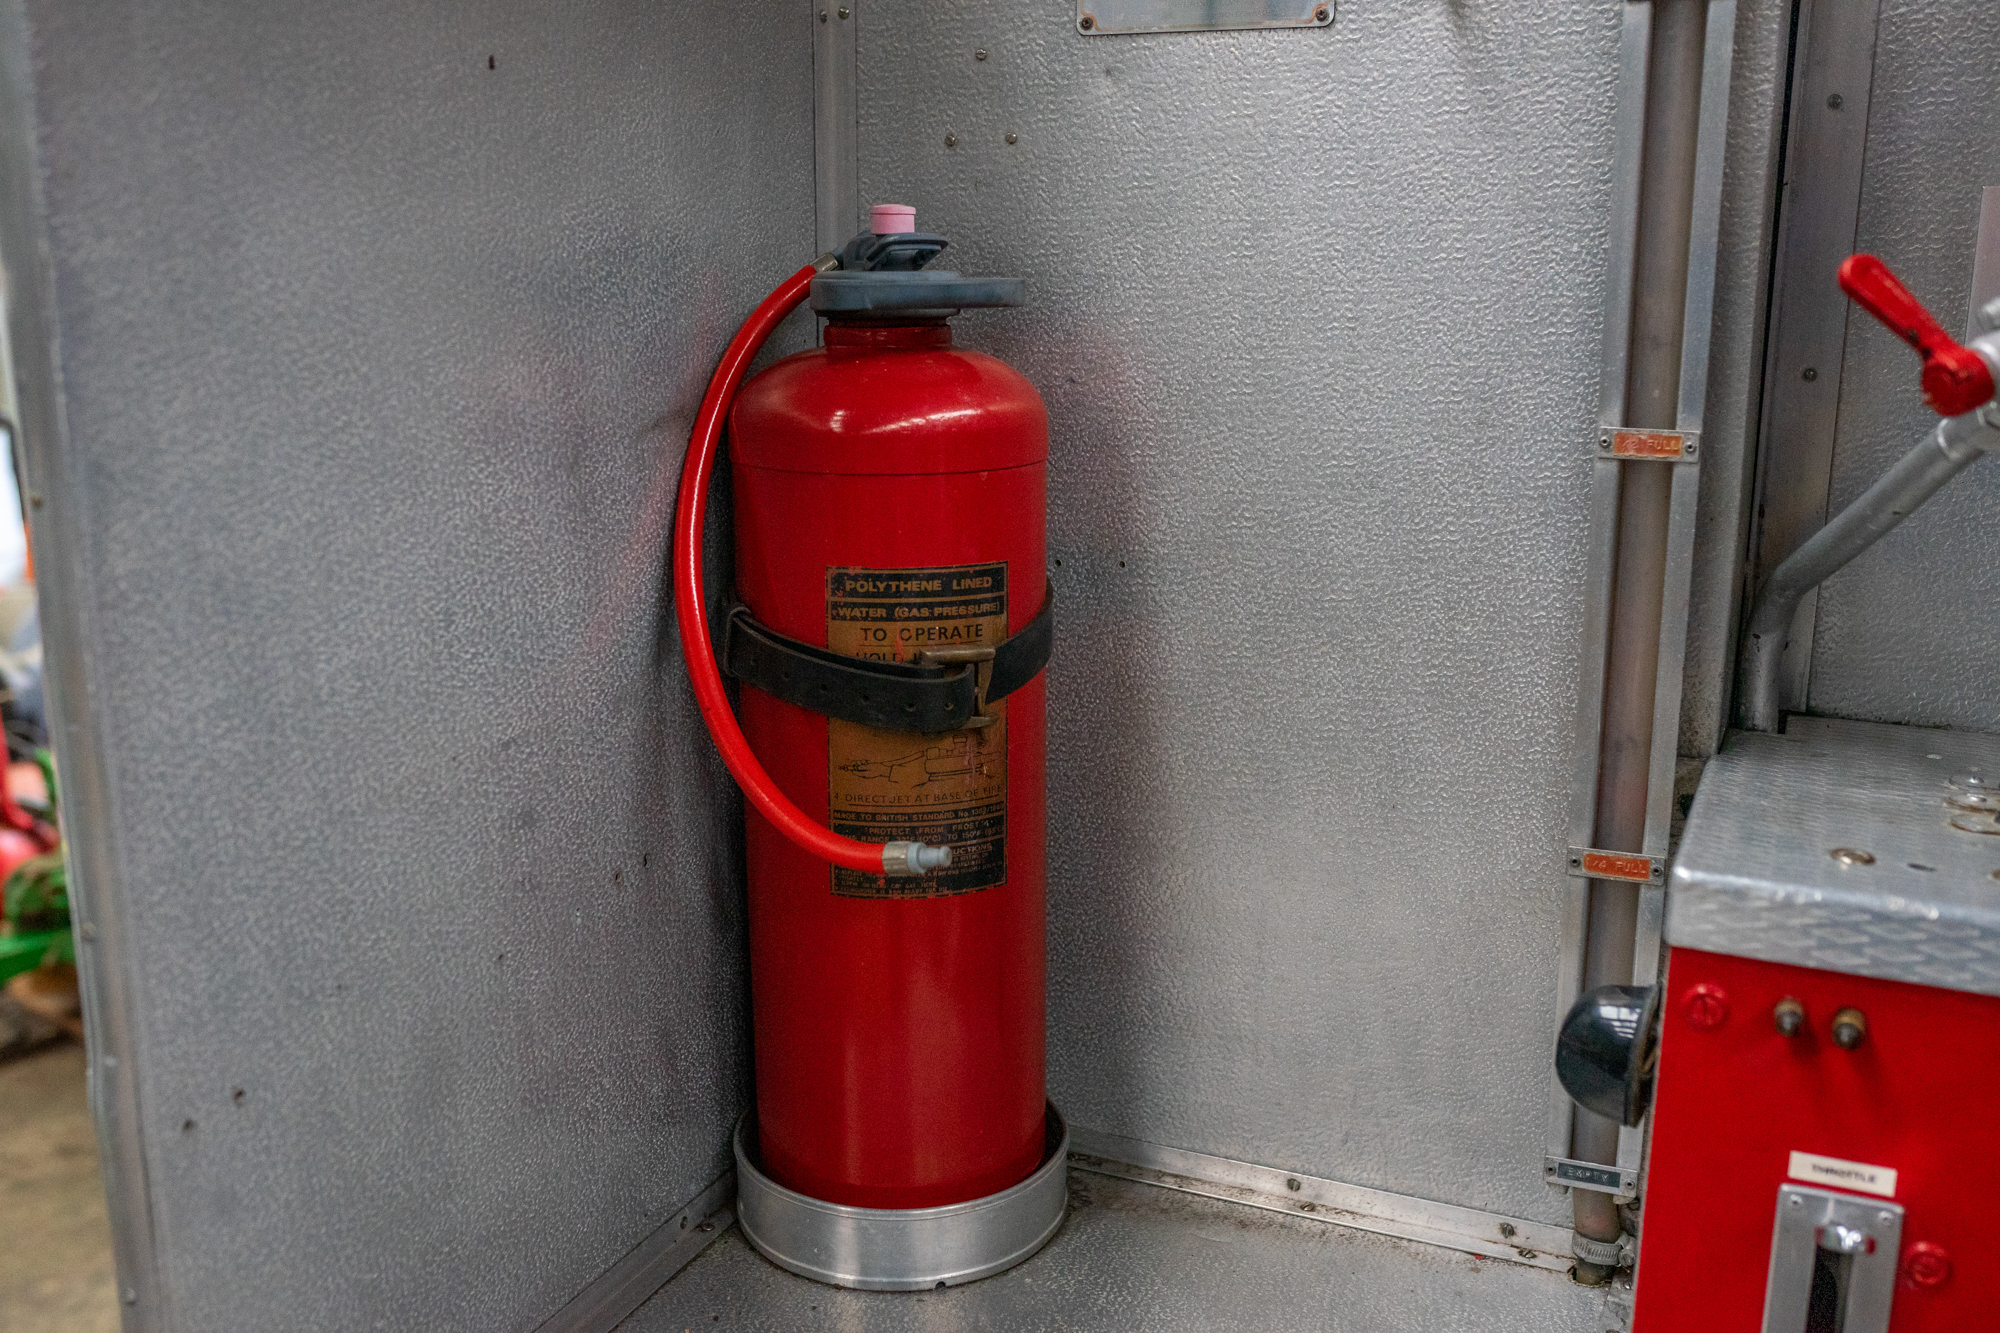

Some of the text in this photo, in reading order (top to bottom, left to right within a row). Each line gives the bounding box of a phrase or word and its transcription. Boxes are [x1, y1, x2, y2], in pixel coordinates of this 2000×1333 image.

[1646, 439, 1679, 451] FULL
[845, 576, 993, 593] POLYTHENE LINED
[837, 606, 887, 618] WATER
[860, 624, 983, 642] TO OPERATE
[845, 794, 887, 804] DIRECT
[888, 795, 911, 804] JET
[915, 793, 930, 803] AT
[934, 791, 960, 802] BASE
[965, 788, 978, 798] OF
[983, 784, 1002, 795] FIRE
[834, 812, 856, 820] MADE
[860, 813, 872, 821] TO
[875, 814, 908, 822] BRITISH
[912, 811, 955, 821] STANDARD
[868, 821, 979, 836] PROTECT FROM FROST
[1616, 861, 1647, 874] FULL
[1568, 1166, 1609, 1183] EMPTY
